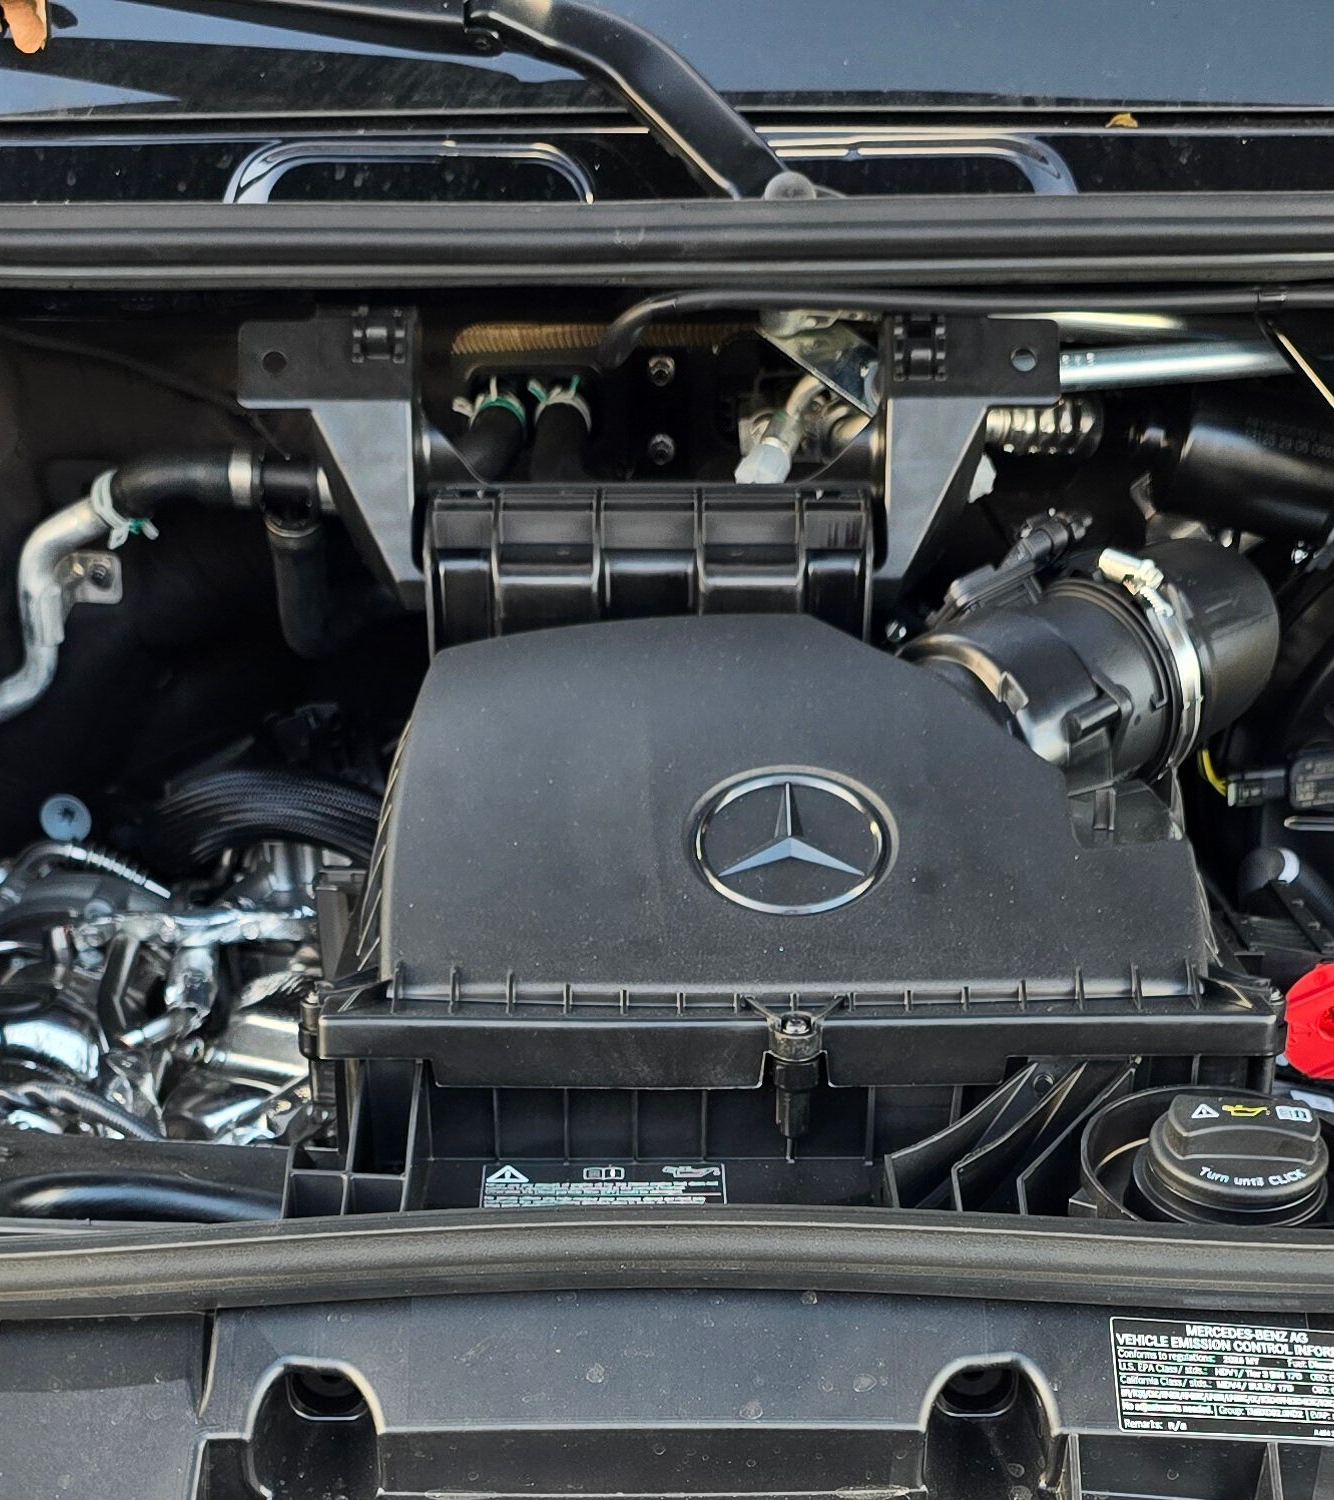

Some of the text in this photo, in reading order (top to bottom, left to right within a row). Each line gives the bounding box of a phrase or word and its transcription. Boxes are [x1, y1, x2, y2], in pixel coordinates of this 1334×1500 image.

[1199, 1166, 1307, 1187] Turn until CLICK
[1185, 1324, 1309, 1344] MERCEDES-BENZ AG
[1115, 1332, 1169, 1347] VEHICLE
[1170, 1336, 1232, 1351] EMISSION
[1232, 1340, 1293, 1355] CONTROL
[1117, 1349, 1157, 1359] Conforms
[1157, 1351, 1167, 1360] to
[1118, 1362, 1135, 1371] U.S.
[1137, 1363, 1154, 1372] EPA
[1119, 1375, 1158, 1385] California
[1123, 1418, 1187, 1430] Remarks: n/a
